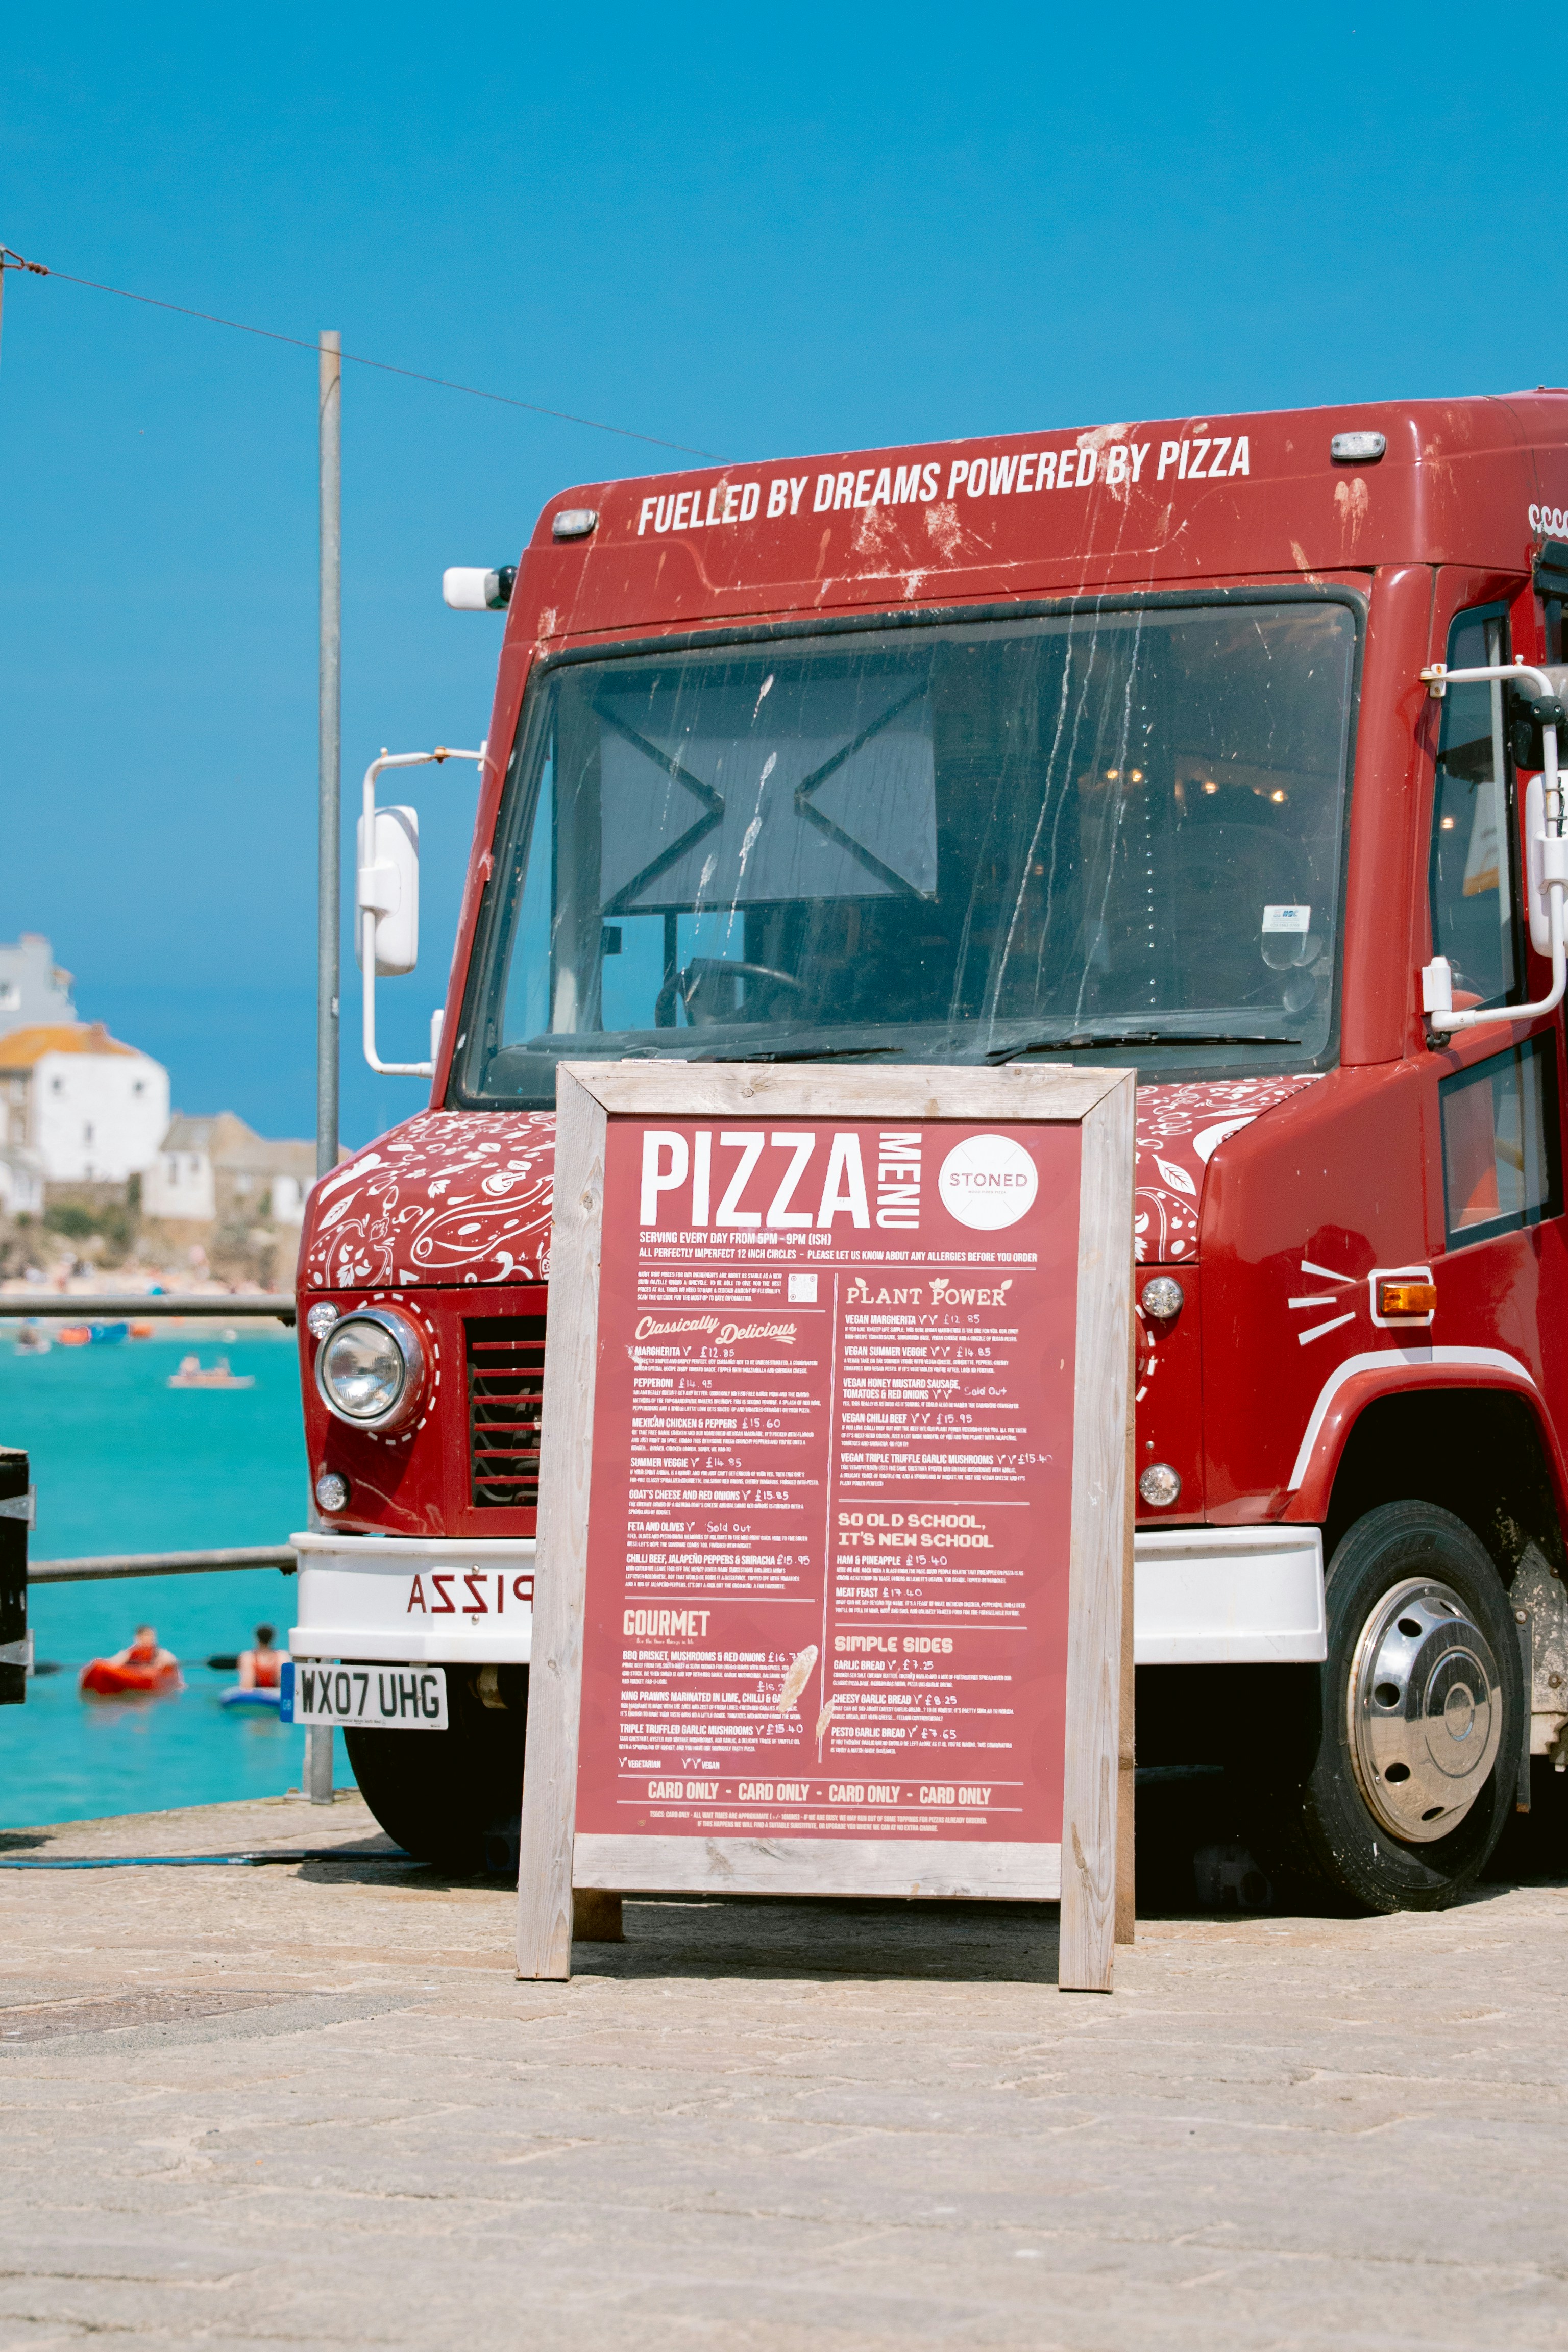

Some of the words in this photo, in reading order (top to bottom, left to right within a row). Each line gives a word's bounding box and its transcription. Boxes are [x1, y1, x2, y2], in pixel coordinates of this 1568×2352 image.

[637, 483, 761, 535] FUELLED
[766, 476, 808, 518] BY
[813, 462, 940, 512] DREAMS
[947, 448, 1098, 499] POWERED
[1106, 443, 1150, 484] BY
[1157, 436, 1250, 480] PIZZA
[640, 1130, 871, 1229] PIZZA
[876, 1132, 922, 1229] MENU
[950, 1173, 1027, 1187] STONED
[640, 1232, 677, 1242] SERVING
[680, 1232, 708, 1243] EVERY
[710, 1233, 727, 1243] DAY
[730, 1233, 756, 1243] FROM
[756, 1233, 777, 1244] 5PM
[785, 1233, 805, 1244] 9PM
[808, 1233, 831, 1245] (ISH)
[639, 1248, 652, 1256] ALL
[654, 1248, 693, 1257] PERFECTLY
[695, 1248, 735, 1258] IMPERFECT
[737, 1249, 746, 1258] 12
[748, 1249, 765, 1258] INCH
[767, 1250, 796, 1258] CIRCLES
[807, 1250, 834, 1259] PLEASE
[836, 1251, 849, 1259] LET
[851, 1251, 860, 1259] US
[862, 1251, 884, 1260] KNOW
[885, 1251, 909, 1260] ABOUT
[911, 1252, 925, 1260] ANY
[927, 1252, 966, 1261] ALLERGIES
[968, 1252, 995, 1261] BEFORE
[997, 1253, 1011, 1261] YOU
[1013, 1253, 1037, 1262] ORDER
[846, 1287, 922, 1304] PLANT
[931, 1287, 1008, 1305] POWER
[845, 1314, 869, 1324] VEGAN
[870, 1315, 916, 1324] MARGHERITA
[635, 1315, 720, 1340] Classically
[715, 1322, 797, 1344] Delicious
[634, 1346, 680, 1356] MARGHERITA
[700, 1346, 734, 1358] £12.85
[844, 1346, 867, 1355] VEGAN
[869, 1346, 900, 1356] SUMMER
[902, 1347, 927, 1356] VEGGIE
[957, 1346, 991, 1358] £14.85
[634, 1378, 673, 1387] PEPPERONI
[679, 1379, 713, 1388] £14.95
[843, 1378, 866, 1387] VEGAN
[868, 1378, 891, 1387] HONEY
[892, 1379, 925, 1388] MUSTARD
[927, 1379, 960, 1390] SAUSAGE,
[843, 1389, 879, 1398] TOMATOES
[888, 1389, 901, 1399] RED
[903, 1390, 928, 1399] ONIONS
[964, 1386, 986, 1396] Sold
[988, 1386, 1008, 1395] Out
[632, 1418, 664, 1427] MEXICAN
[666, 1418, 697, 1428] CHICKEN
[705, 1419, 737, 1428] PEPPERS
[742, 1417, 781, 1429] £15.60
[842, 1413, 865, 1422] VEGAN
[867, 1413, 888, 1423] CHILLI
[889, 1414, 907, 1423] BEEF
[936, 1413, 972, 1424] £15.95
[630, 1458, 661, 1466] SUMMER
[664, 1458, 688, 1467] VEGGIE
[706, 1457, 742, 1468] £14.85
[841, 1453, 863, 1462] VEGAN
[865, 1453, 889, 1462] TRIPLE
[891, 1454, 920, 1463] TRUFFLE
[922, 1454, 947, 1463] GARLIC
[948, 1455, 993, 1464] MUSHROOMS
[629, 1489, 653, 1499] GOAT'S
[655, 1490, 681, 1499] CHEESE
[682, 1490, 697, 1499] AND
[698, 1490, 712, 1500] RED
[714, 1490, 740, 1500] ONIONS
[755, 1490, 789, 1502] £15.85
[628, 1522, 644, 1530] FETA
[645, 1522, 659, 1531] AND
[661, 1522, 684, 1531] OLIVES
[706, 1521, 728, 1532] Sold
[733, 1523, 752, 1532] Out
[838, 1513, 863, 1526] SO
[867, 1514, 903, 1526] OLD
[908, 1514, 985, 1529] SCHOOL,
[839, 1532, 875, 1545] IT'S
[879, 1533, 917, 1546] NEW
[921, 1534, 993, 1547] SCHOOL
[626, 1554, 647, 1563] CHILLI
[649, 1554, 667, 1565] BEEF,
[668, 1553, 702, 1563] JALAPEÑO
[703, 1555, 733, 1564] PEPPERS
[741, 1555, 775, 1564] SRIRACHA
[777, 1555, 810, 1565] £15.95
[837, 1555, 853, 1564] HAM
[862, 1556, 900, 1565] PINEAPPLE
[905, 1554, 948, 1566] £15.40
[836, 1587, 855, 1597] MEAT
[856, 1587, 878, 1597] FEAST
[883, 1587, 922, 1598] £17.40
[623, 1610, 710, 1636] GOURMET
[835, 1636, 897, 1652] SIMPLE
[903, 1637, 952, 1653] SIDES
[623, 1651, 637, 1660] BBQ
[639, 1651, 669, 1662] BRISKET,
[671, 1651, 716, 1661] MUSHROOMS
[724, 1652, 738, 1661] RED
[739, 1652, 765, 1662] ONIONS
[768, 1652, 802, 1662] £16.7
[834, 1660, 859, 1670] GARLIC
[861, 1660, 885, 1670] BREAD
[301, 1670, 369, 1716] WX07
[378, 1673, 440, 1719] UHG
[621, 1691, 638, 1700] KING
[640, 1691, 669, 1701] PRAWNS
[671, 1692, 711, 1702] MARINATED
[713, 1693, 720, 1702] IN
[722, 1693, 740, 1704] LIME,
[742, 1693, 764, 1702] CHILLI
[831, 1694, 860, 1703] CHEESY
[861, 1694, 886, 1704] GARLIC
[888, 1695, 911, 1704] BREAD
[282, 1699, 291, 1710] GB
[620, 1724, 644, 1733] TRIPLE
[645, 1724, 680, 1734] TRUFFLED
[681, 1725, 706, 1734] GARLIC
[708, 1725, 753, 1735] MUSHROOMS
[767, 1724, 803, 1735] £15.40
[831, 1727, 853, 1736] PESTO
[855, 1727, 880, 1737] GARLIC
[881, 1728, 905, 1737] BREAD
[648, 1781, 683, 1798] CARD
[686, 1782, 719, 1799] ONLY
[739, 1783, 773, 1800] CARD
[777, 1784, 809, 1801] ONLY
[829, 1785, 864, 1802] CARD
[868, 1785, 900, 1802] ONLY
[920, 1786, 954, 1803] CARD
[959, 1787, 991, 1804] ONLY
